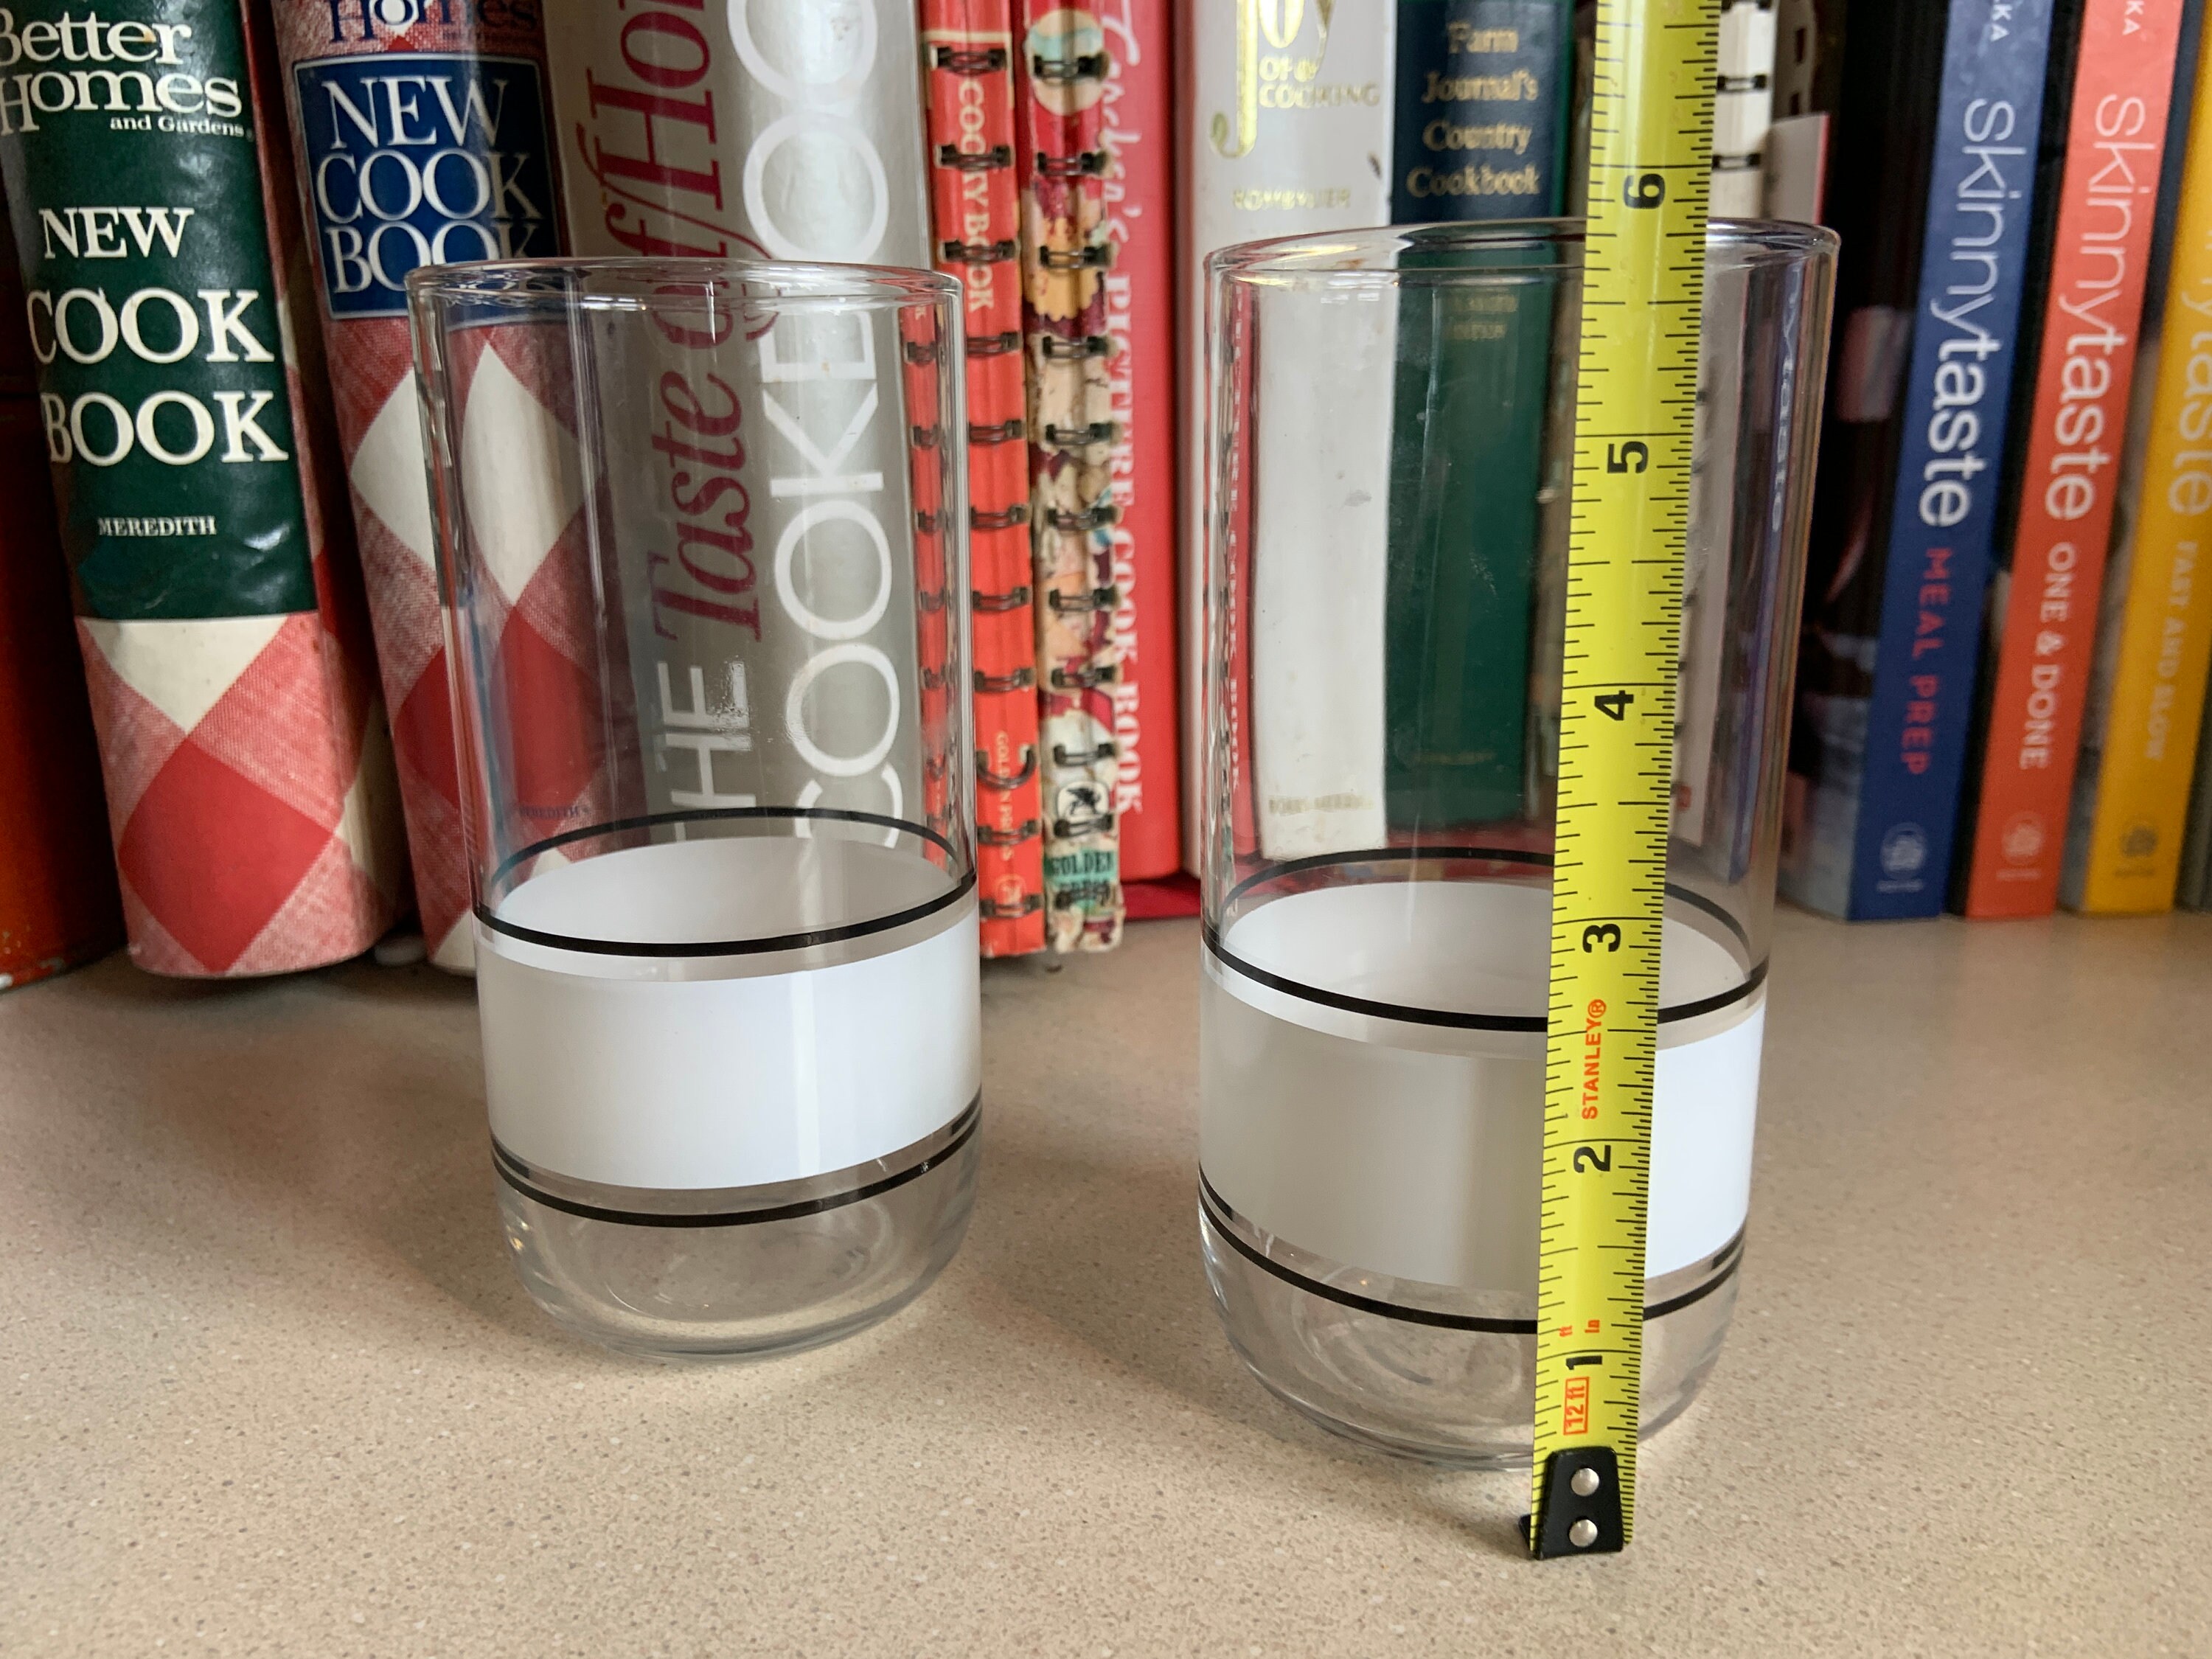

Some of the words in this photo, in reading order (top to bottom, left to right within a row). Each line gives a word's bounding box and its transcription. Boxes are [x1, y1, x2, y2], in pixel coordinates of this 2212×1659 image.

[0, 8, 192, 66] Better
[1447, 21, 1519, 54] Farm
[1991, 0, 2013, 41] KA
[0, 70, 242, 136] Homes
[322, 77, 509, 147] NEW
[586, 0, 725, 212] Ho
[1259, 83, 1380, 108] COOKING
[1422, 68, 1539, 103] Journal's
[111, 114, 151, 131] and
[158, 116, 244, 137] Gardens
[1422, 120, 1533, 155] Country
[317, 149, 541, 223] COOK
[1406, 165, 1541, 198] Cookbook
[1623, 173, 1666, 209] 6
[39, 207, 194, 259] NEW
[964, 212, 995, 313] BOOK
[27, 288, 274, 364] COOK
[1919, 98, 2026, 526] Skinnytaste
[2045, 94, 2155, 521] Skinnytaste
[41, 391, 288, 466] BOOK
[1607, 441, 1649, 473] 5
[98, 516, 217, 537] MEREDITH
[647, 371, 762, 641] Taste
[1111, 529, 1138, 666] COOK
[1911, 547, 1952, 657] MEAL
[2040, 542, 2076, 622] ONE
[2035, 632, 2066, 655] &
[1594, 690, 1634, 721] 4
[1901, 675, 1939, 774] PREP
[2019, 665, 2060, 769] DONE
[658, 662, 756, 841] HE
[997, 731, 1011, 804] GOLDN
[1115, 683, 1143, 813] BOOK
[1000, 804, 1015, 861] PRES
[1582, 923, 1621, 953] 3
[1573, 1144, 1612, 1174] 2
[1565, 1355, 1603, 1370] 1
[1565, 1404, 1585, 1429] 12
[1566, 1385, 1585, 1400] ft
